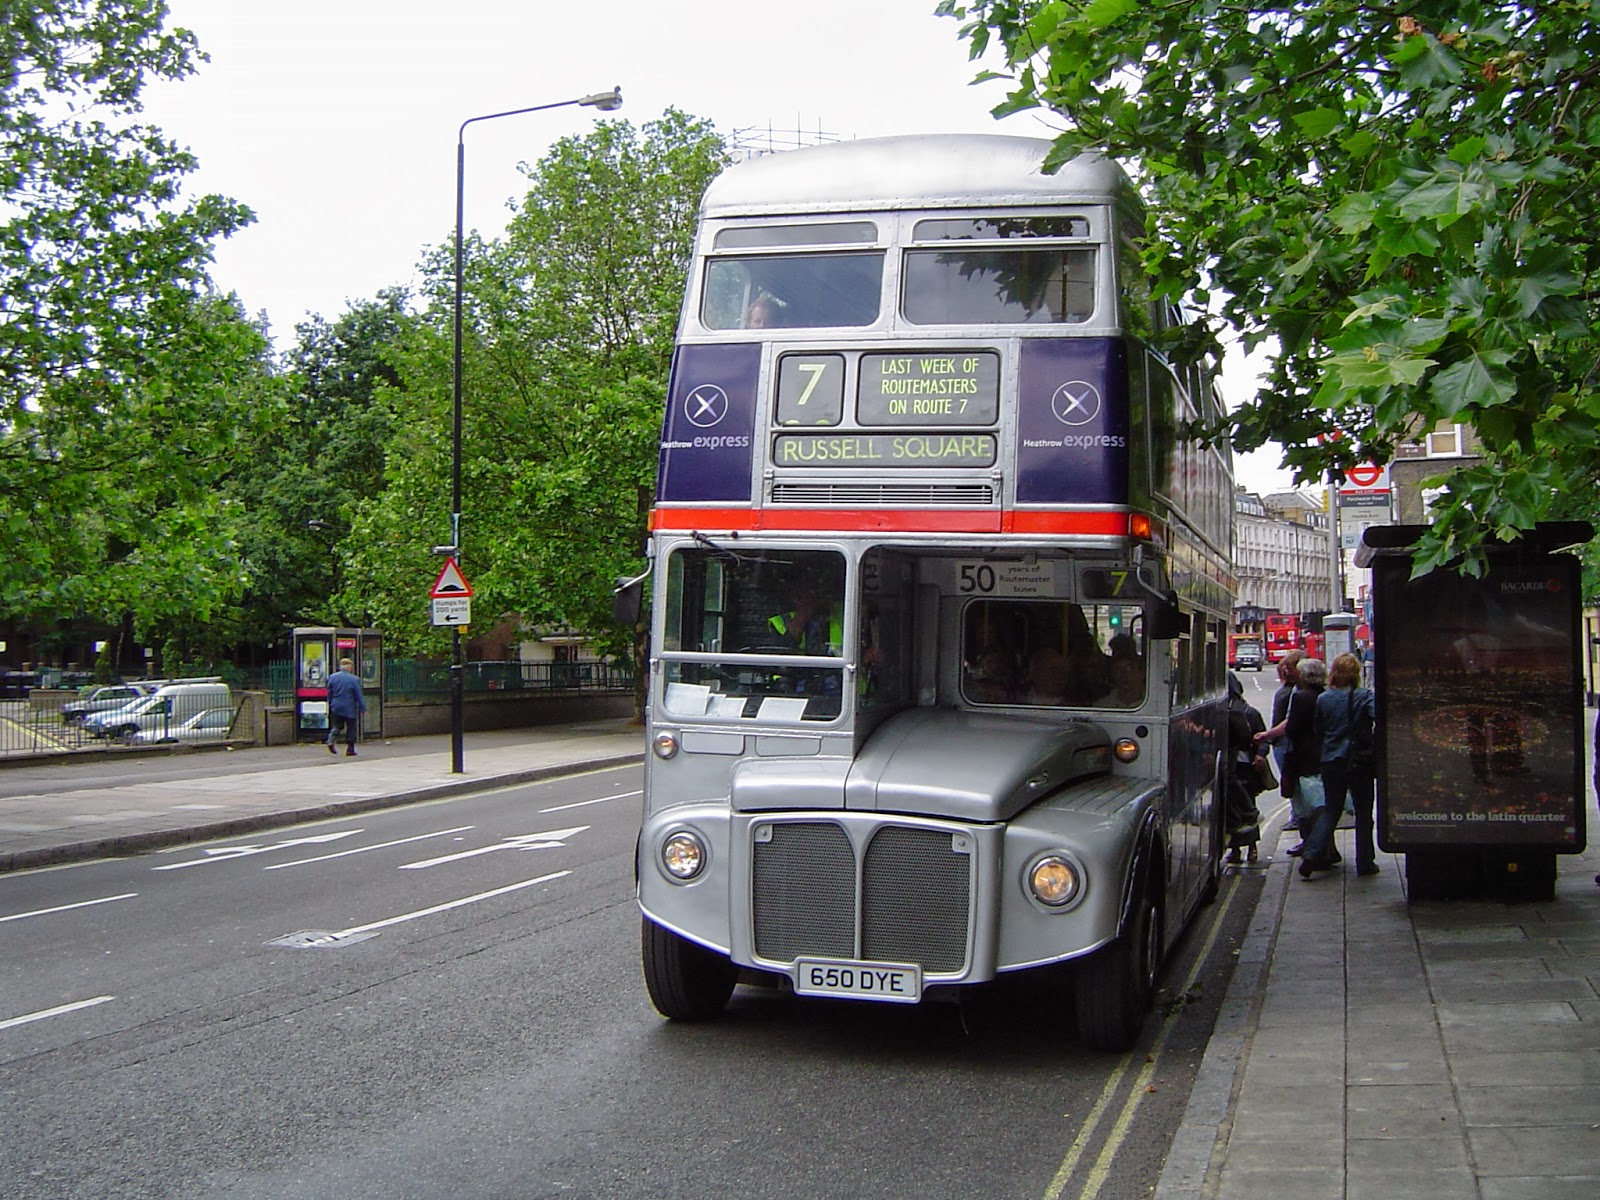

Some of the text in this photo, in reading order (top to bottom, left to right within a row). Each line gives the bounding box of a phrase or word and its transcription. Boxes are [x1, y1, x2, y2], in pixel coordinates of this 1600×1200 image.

[881, 357, 979, 374] LAST WEEK OF
[798, 363, 826, 405] 7
[881, 378, 977, 394] ROUTEMASTERS
[889, 398, 968, 414] ON ROUTE 7
[693, 435, 749, 450] express
[783, 437, 992, 461] RUSSELL SQUARE
[1023, 434, 1126, 450] Heathrow express
[1032, 564, 1040, 572] of
[960, 564, 996, 592] 50
[1000, 574, 1050, 582] Routemaster
[1110, 571, 1128, 596] 7
[1500, 581, 1544, 590] BACARDI
[1395, 811, 1566, 824] welcome to the latin quarter
[811, 968, 904, 992] 650 DYE
